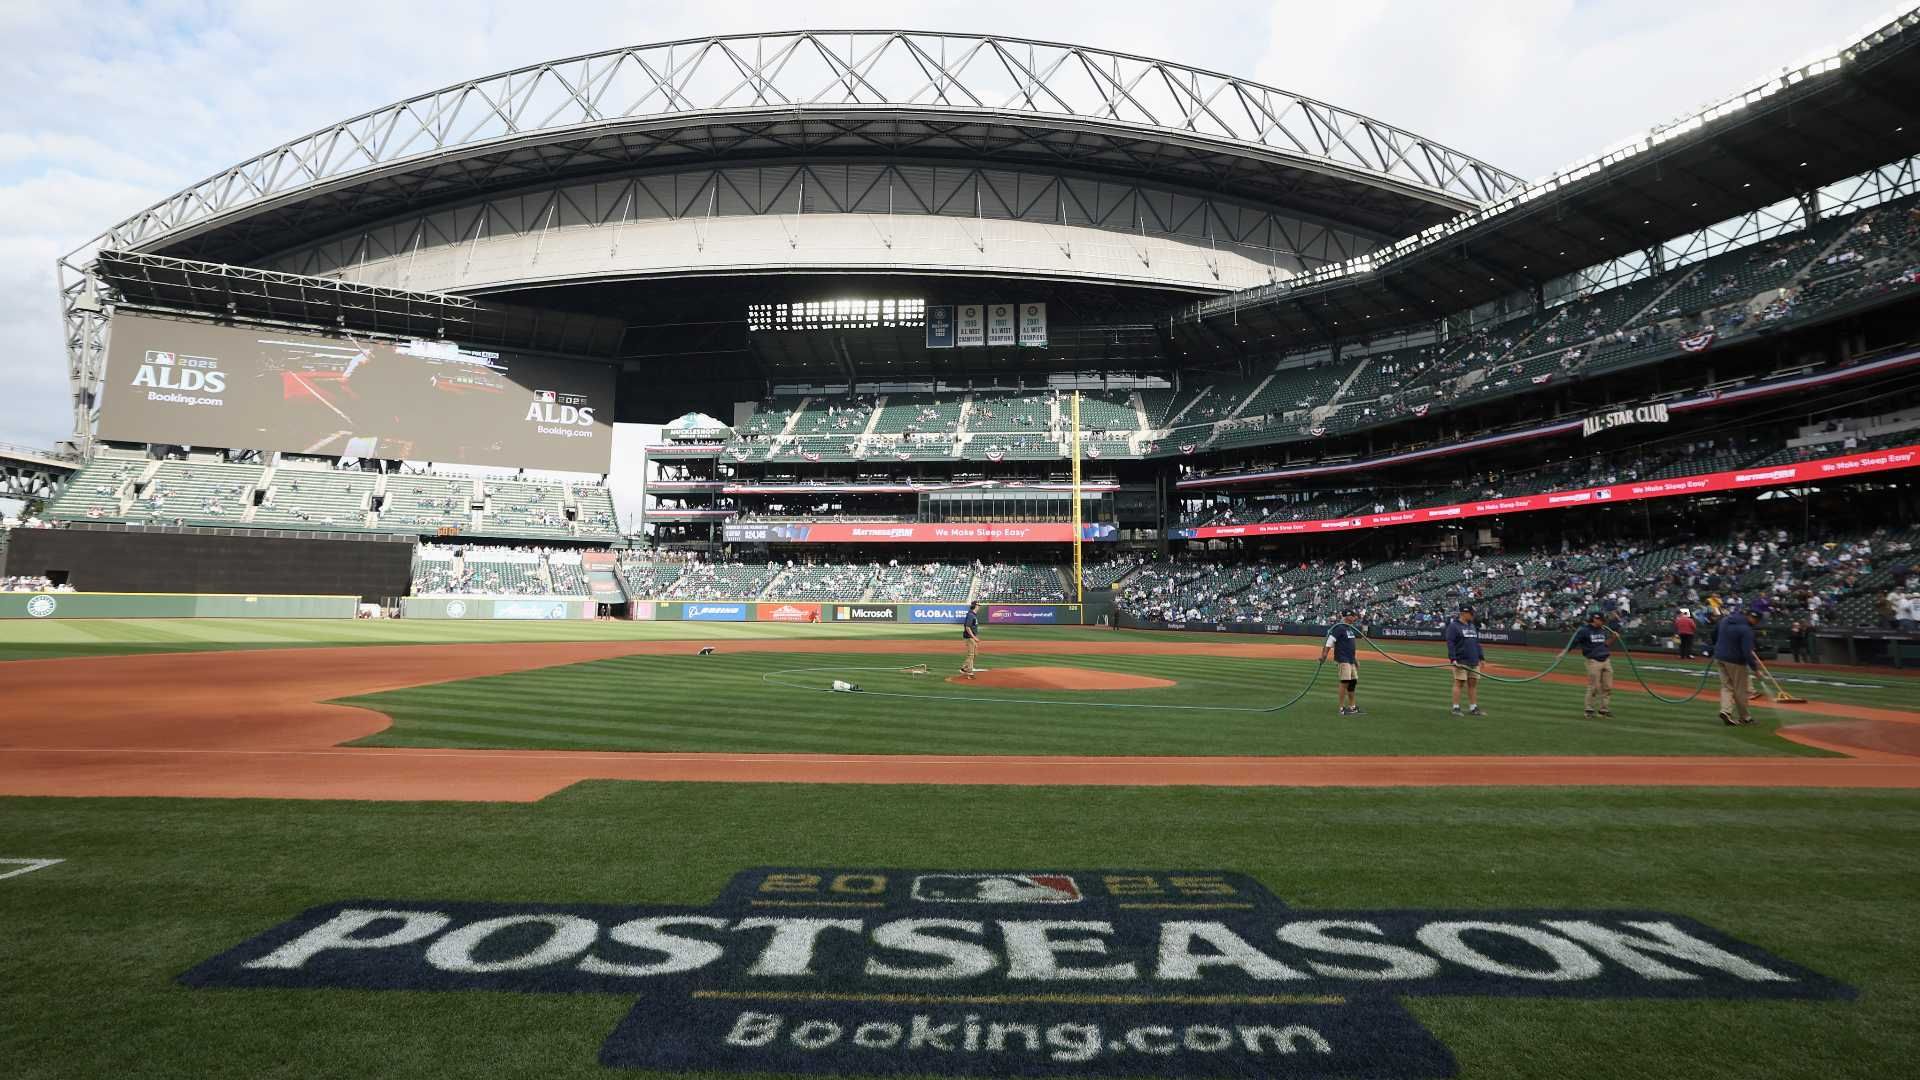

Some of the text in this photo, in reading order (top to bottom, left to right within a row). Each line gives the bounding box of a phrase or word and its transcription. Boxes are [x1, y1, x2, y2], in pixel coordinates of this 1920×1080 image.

[178, 358, 217, 369] 2025
[129, 364, 226, 393] ALDS
[147, 391, 223, 406] Booking.com
[558, 396, 588, 406] 2025
[525, 402, 595, 426] ALDS
[1635, 403, 1669, 423] CLUB
[537, 425, 593, 437] Booking.com
[1836, 461, 1859, 469] Make
[1860, 457, 1887, 466] Sleep
[1888, 454, 1911, 463] Easy
[935, 528, 1025, 538] We Make Sleep Easy
[851, 608, 893, 618] Microsoft
[914, 609, 954, 618] GLOBAL
[240, 908, 1797, 984] POSTSEASON
[724, 1011, 1333, 1062] Booking.com
